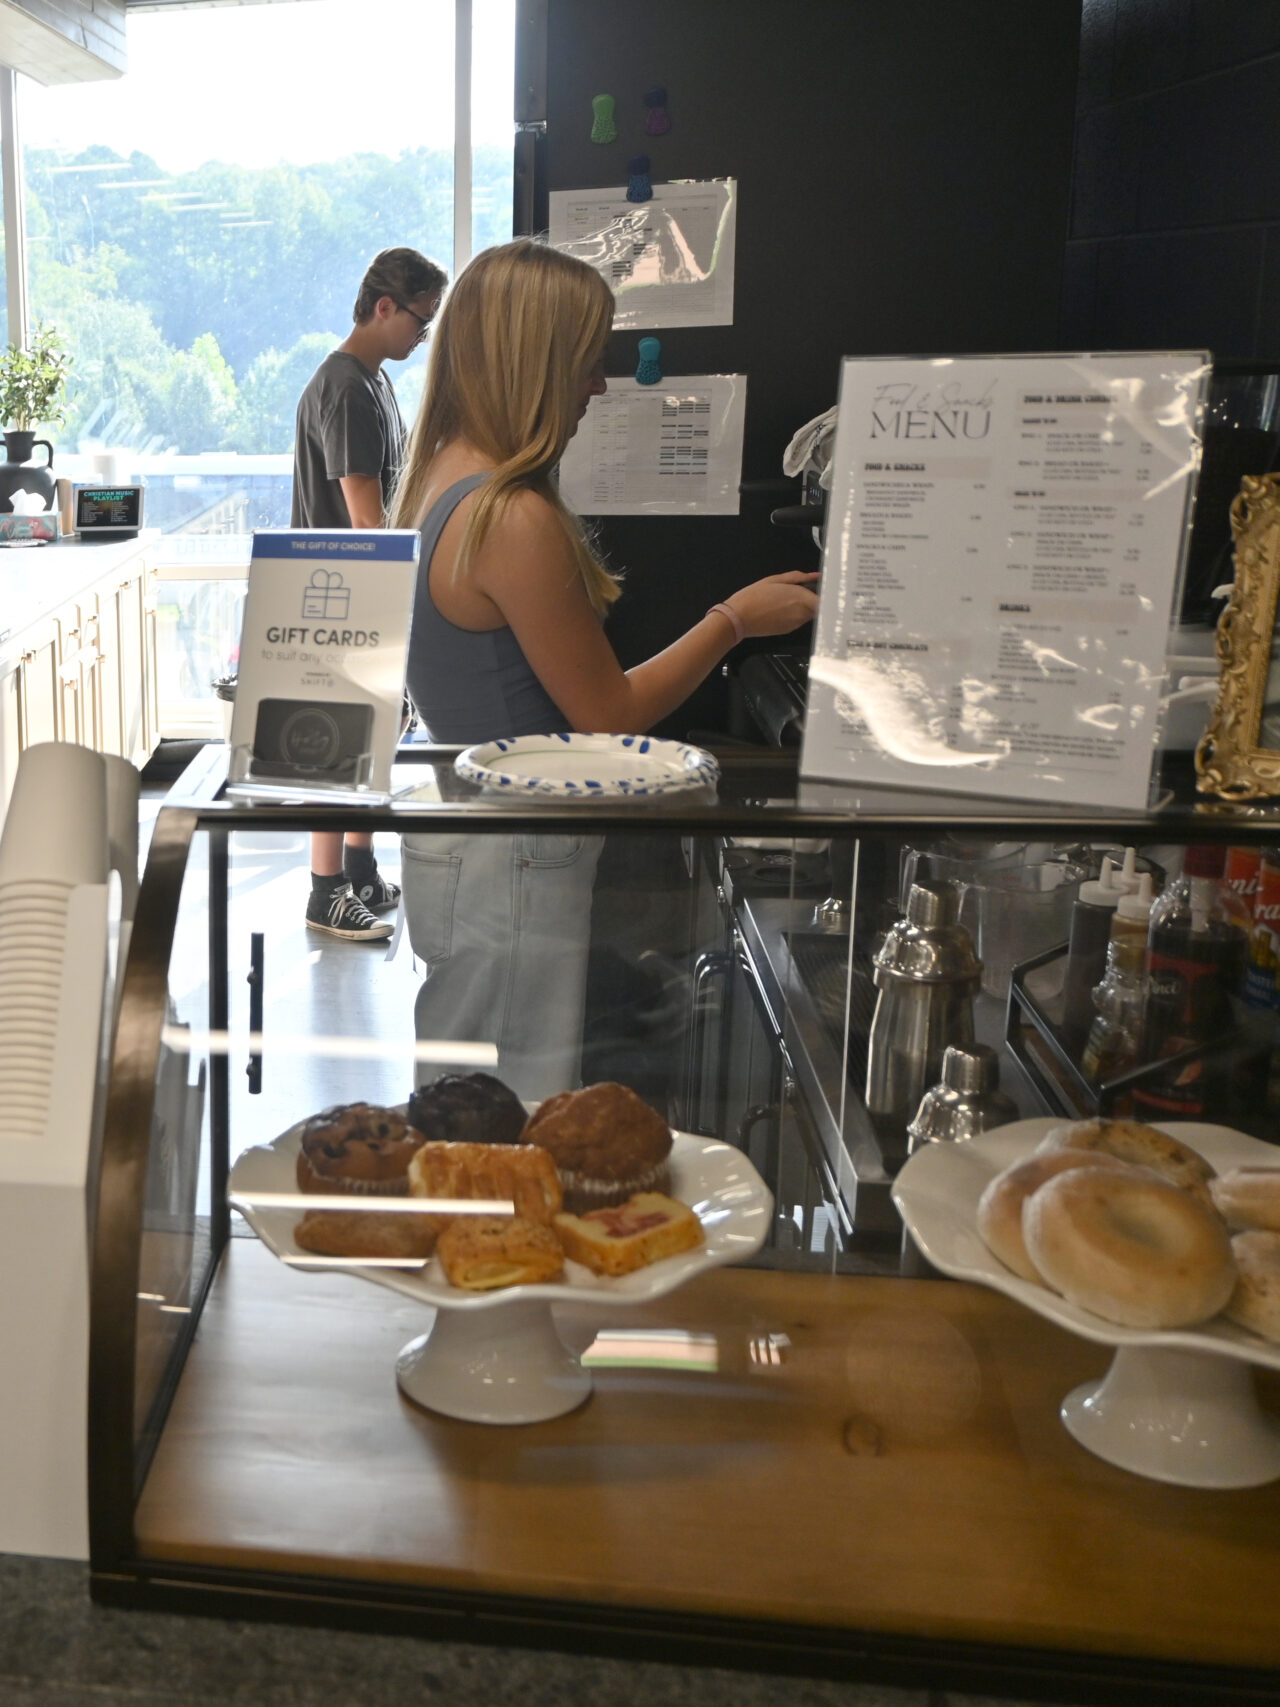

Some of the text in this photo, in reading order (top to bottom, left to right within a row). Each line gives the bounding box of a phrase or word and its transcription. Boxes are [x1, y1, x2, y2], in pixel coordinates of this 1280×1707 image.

[870, 411, 991, 439] MENU
[291, 541, 306, 549] THE
[308, 541, 326, 550] GIFT
[327, 542, 339, 550] OF
[267, 627, 380, 647] GIFT CARDS
[261, 649, 273, 660] to
[276, 650, 297, 661] suit
